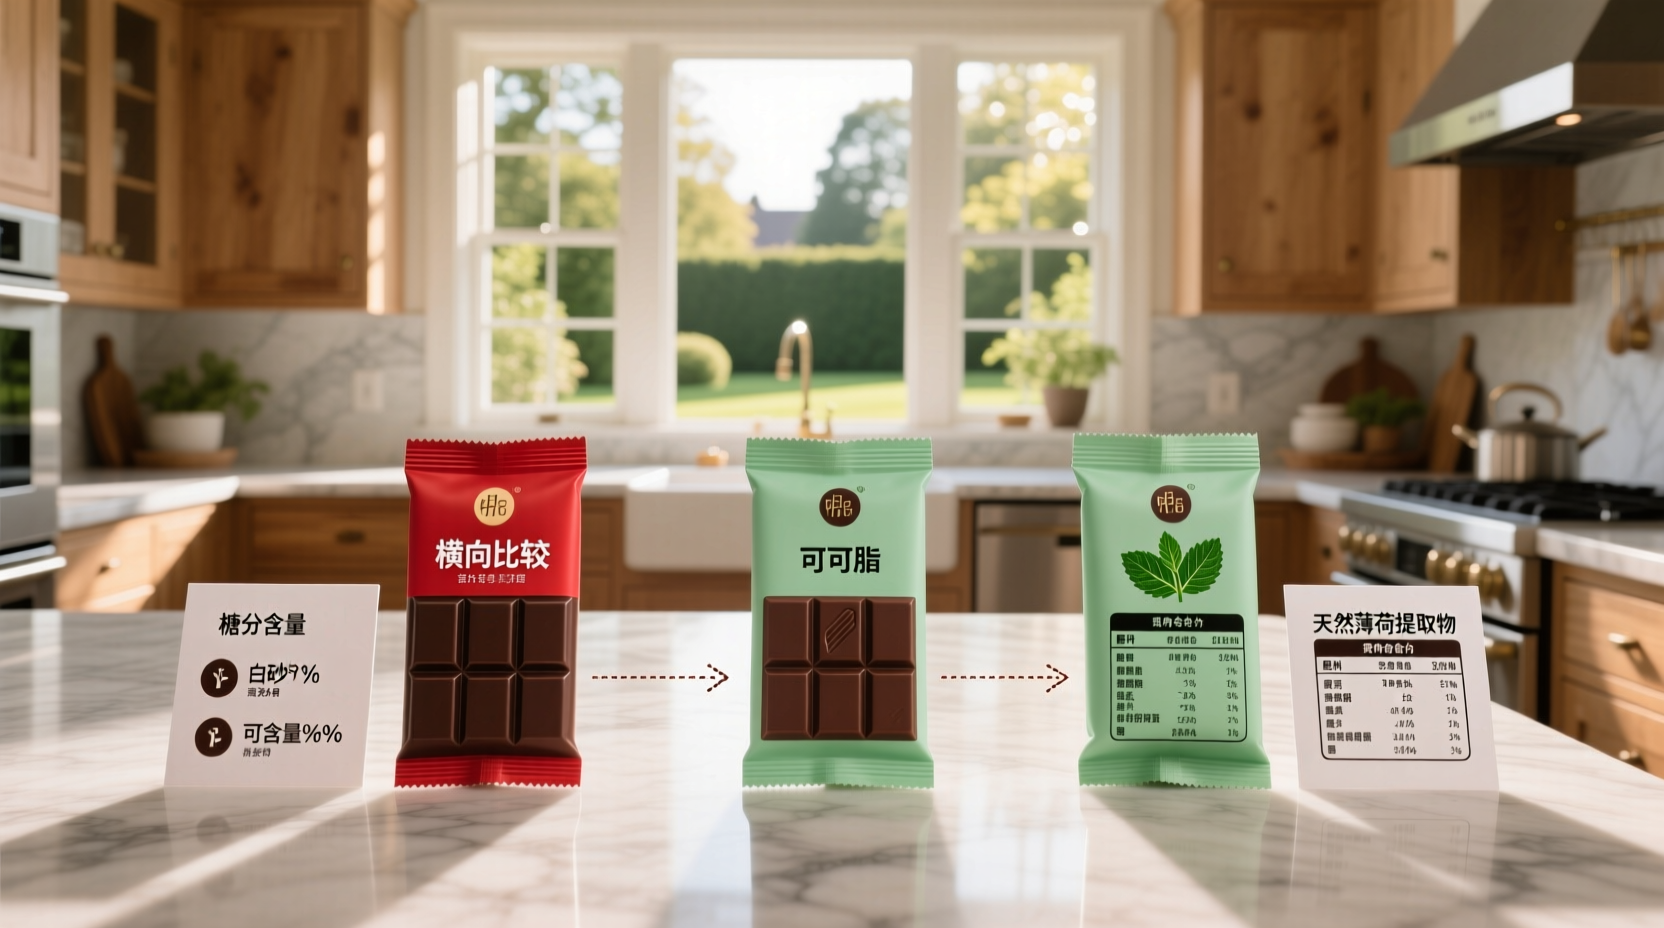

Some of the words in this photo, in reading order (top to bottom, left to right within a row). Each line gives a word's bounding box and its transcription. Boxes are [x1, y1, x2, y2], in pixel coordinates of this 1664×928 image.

[435, 538, 550, 570] 横向比较
[800, 546, 880, 573] 可可脂
[219, 612, 306, 636] 糖分含量
[1313, 611, 1456, 635] 天然薄荷提取物
[243, 722, 343, 744] 可含量%%
